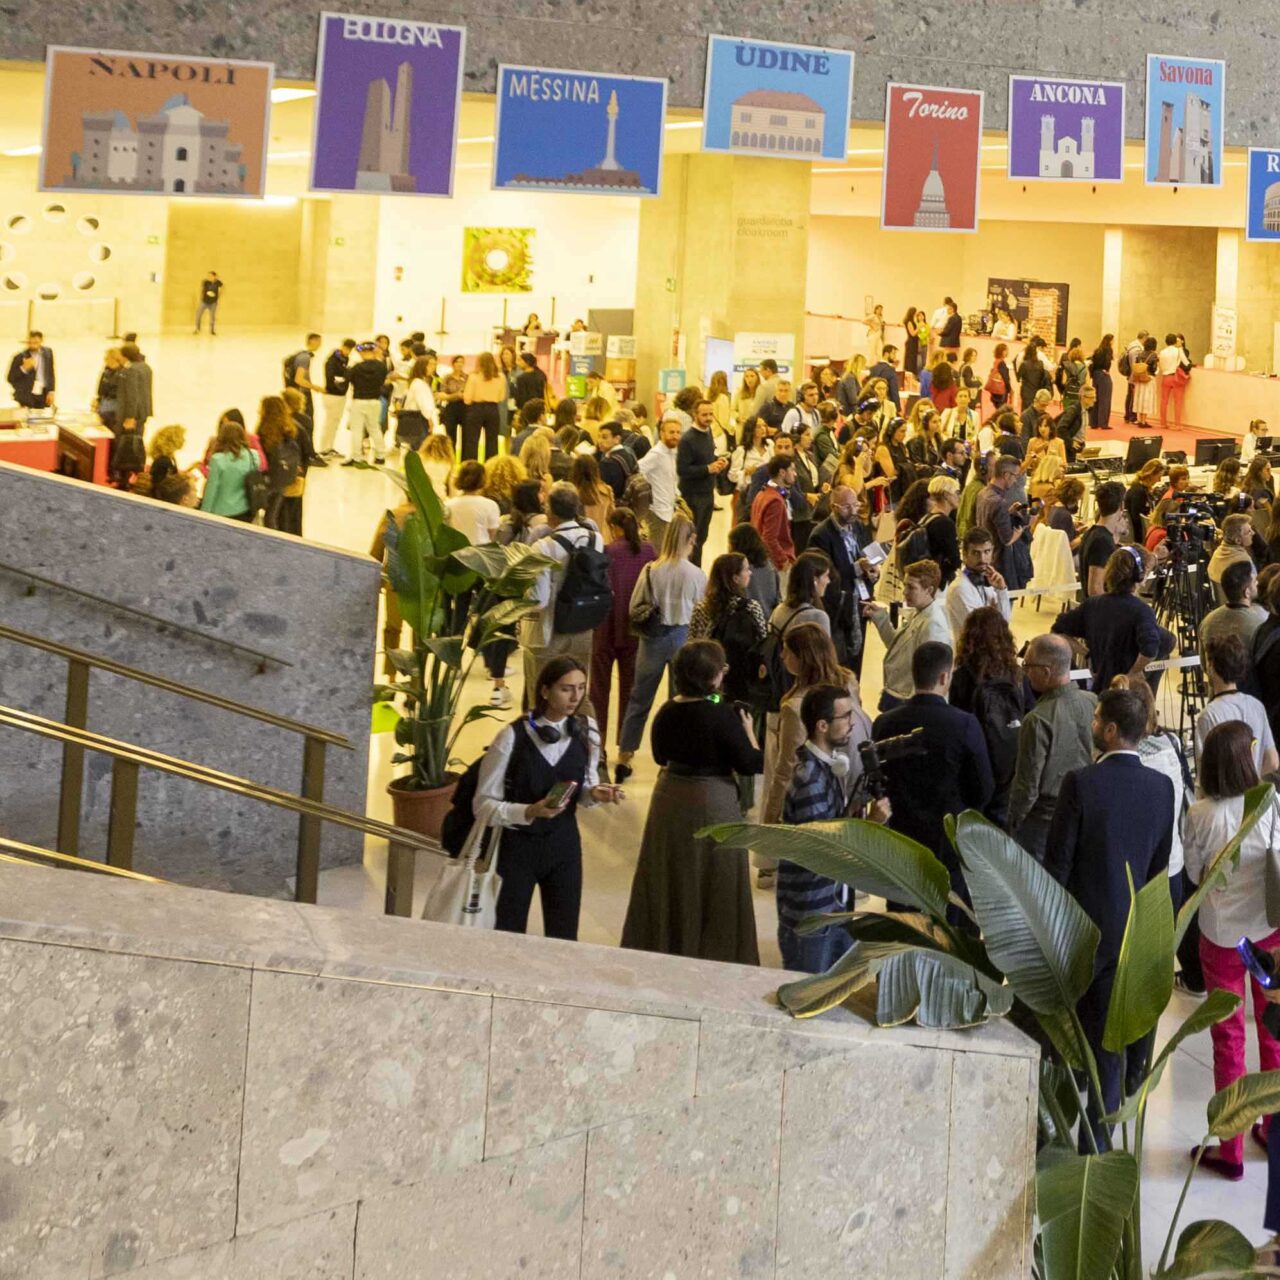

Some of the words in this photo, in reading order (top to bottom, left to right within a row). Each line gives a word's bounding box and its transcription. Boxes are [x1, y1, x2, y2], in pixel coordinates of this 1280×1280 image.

[343, 17, 443, 49] BOLOGNA
[89, 57, 236, 86] NAPOLI
[734, 45, 830, 76] UDINE
[1159, 62, 1213, 86] Savona
[509, 73, 600, 104] MESSINA
[1029, 83, 1107, 106] ANCONA
[902, 92, 969, 120] Torino
